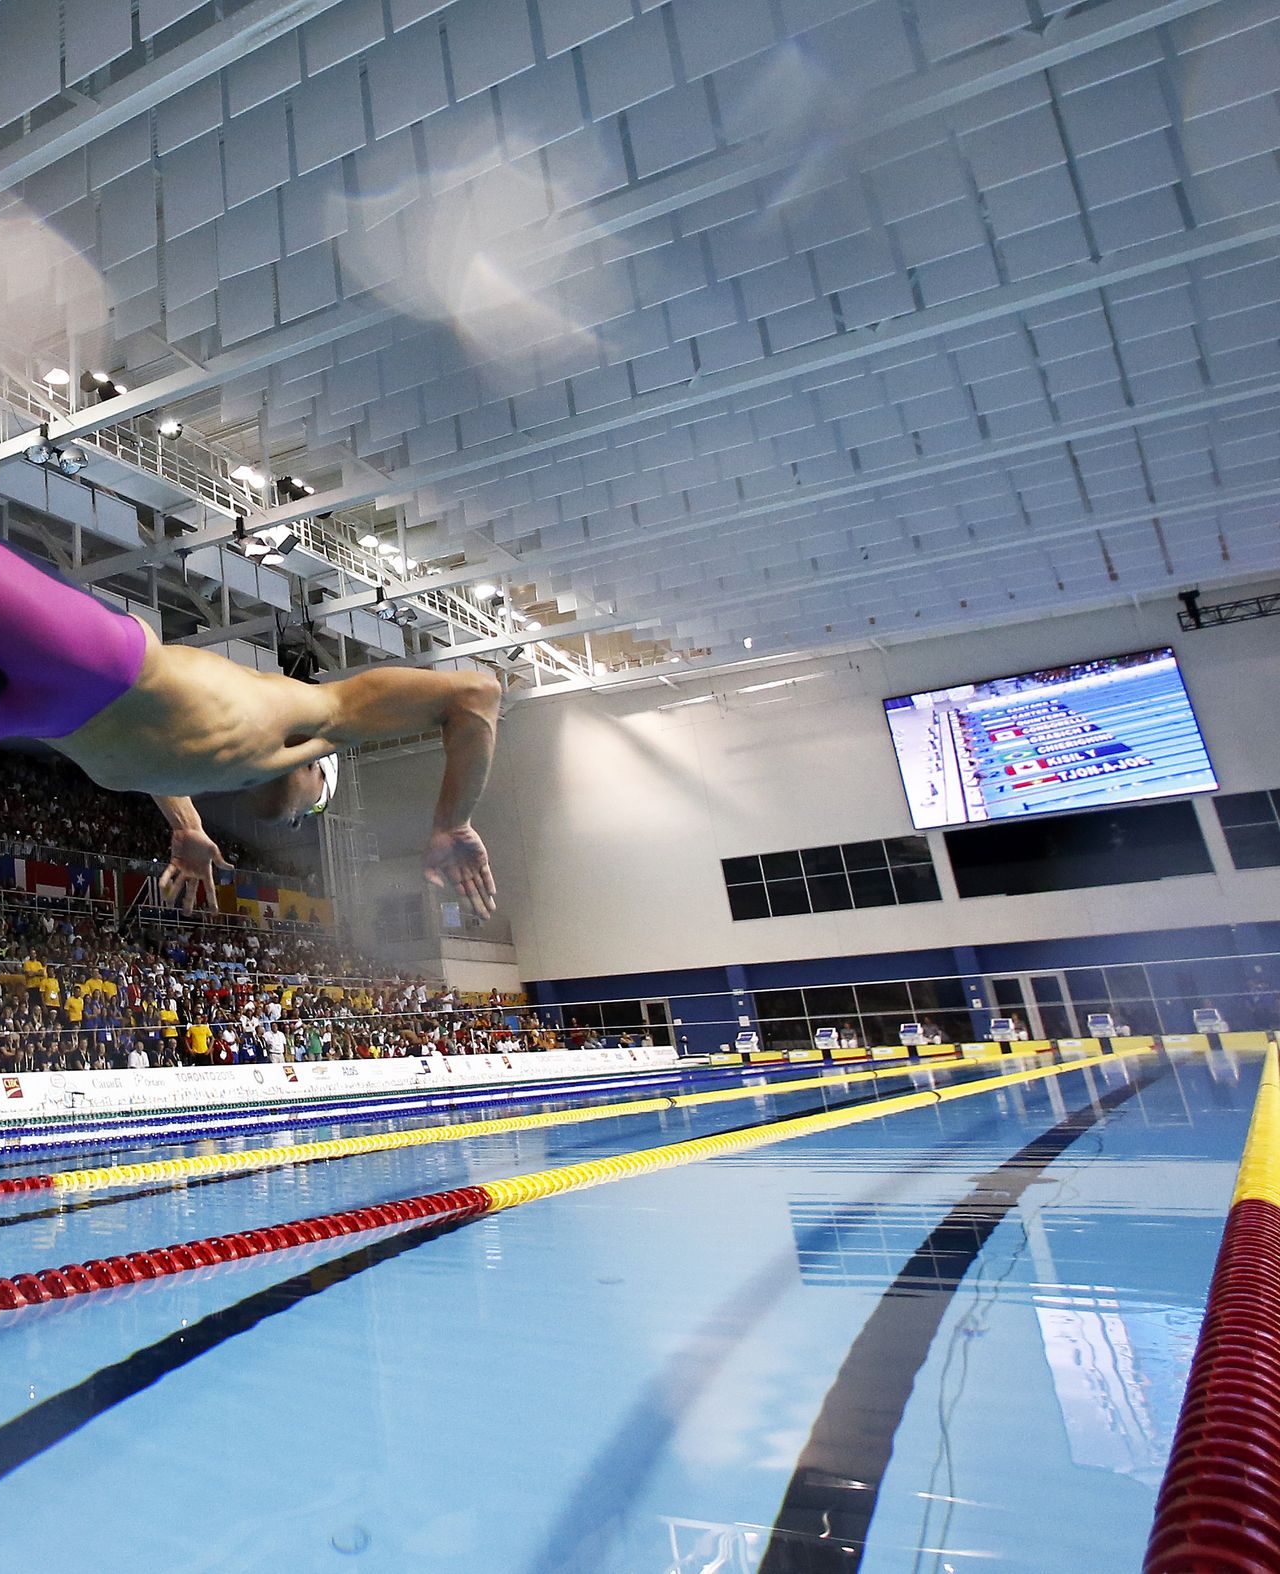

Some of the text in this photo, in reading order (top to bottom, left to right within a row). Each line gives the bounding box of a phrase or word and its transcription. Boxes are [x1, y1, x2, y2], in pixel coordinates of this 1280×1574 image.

[1046, 752, 1085, 767] KISIL
[1085, 749, 1097, 758] Y
[996, 756, 1150, 793] 1 TJON-A-JOE
